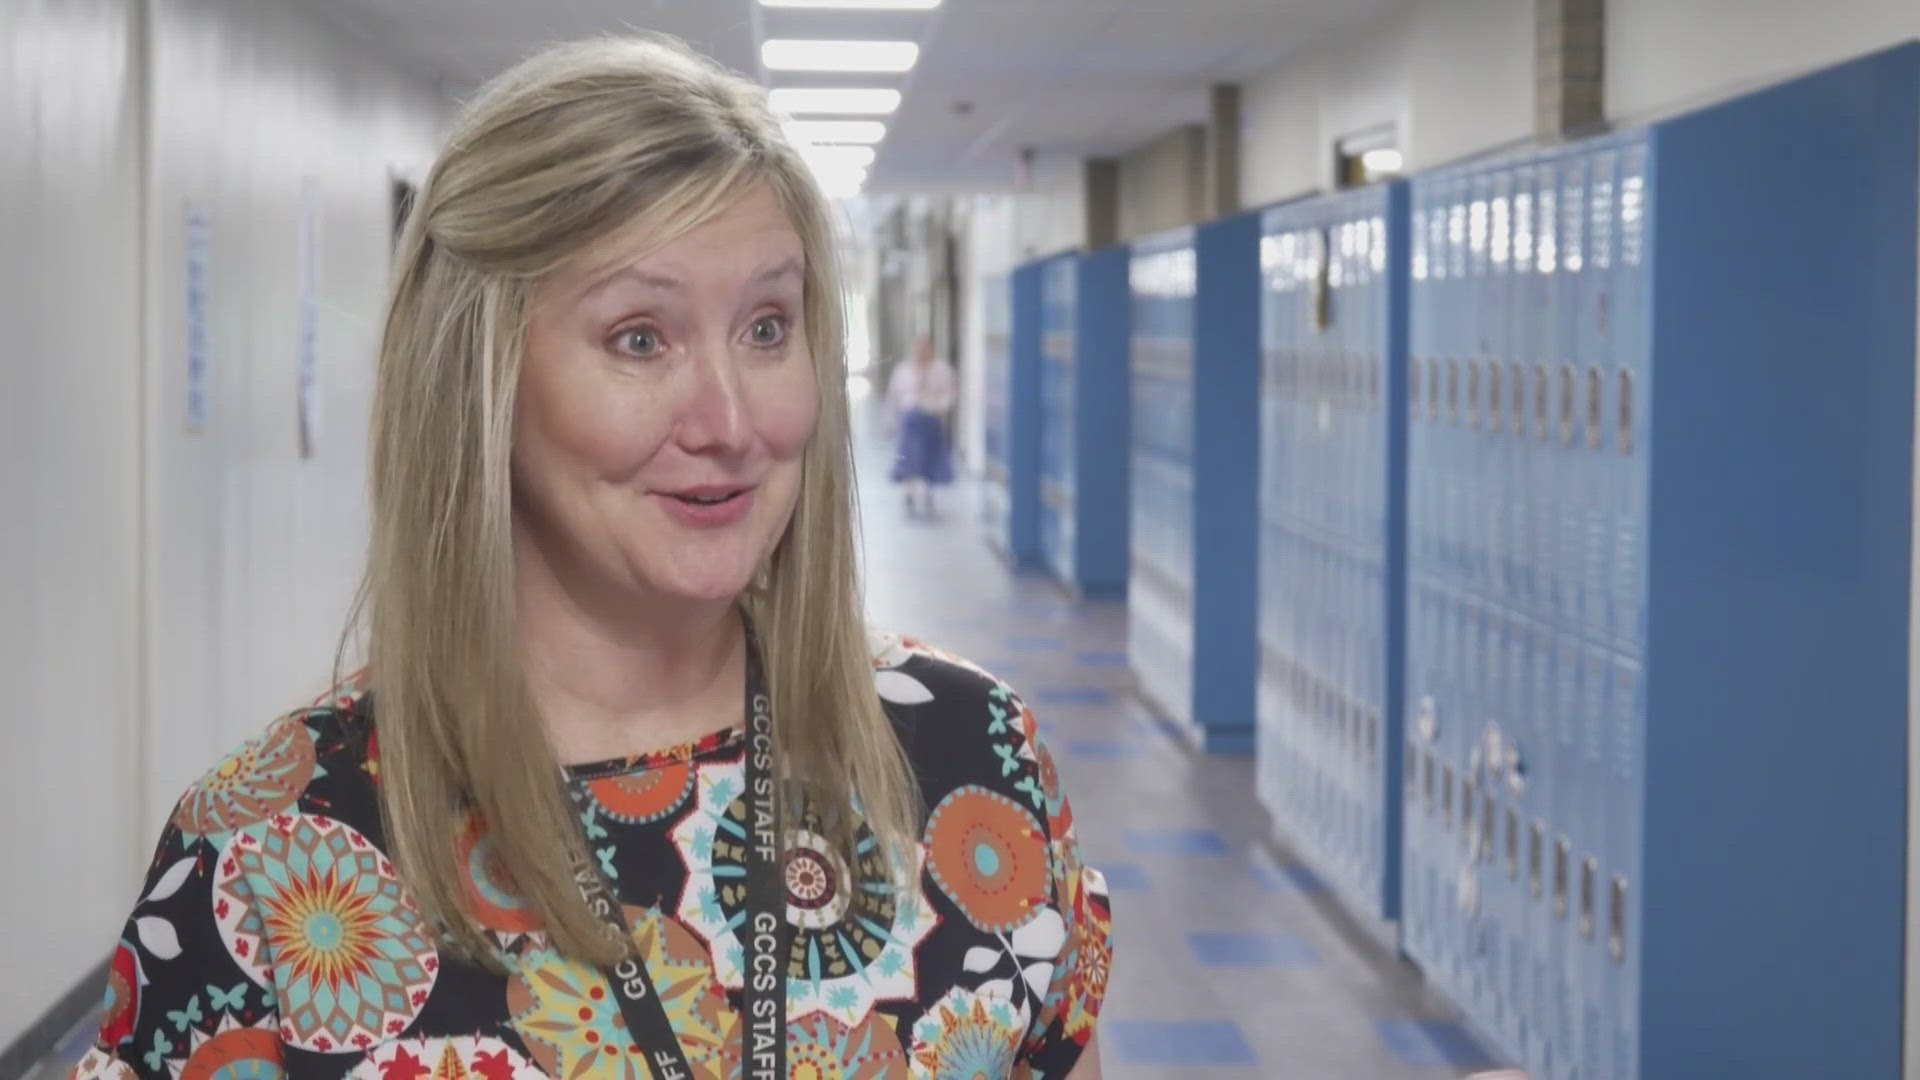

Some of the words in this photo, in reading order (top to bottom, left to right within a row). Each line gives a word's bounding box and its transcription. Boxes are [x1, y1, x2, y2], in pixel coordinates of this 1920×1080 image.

[752, 693, 773, 771] GCCS
[754, 777, 776, 863] STAFF
[752, 911, 778, 992] GCCS
